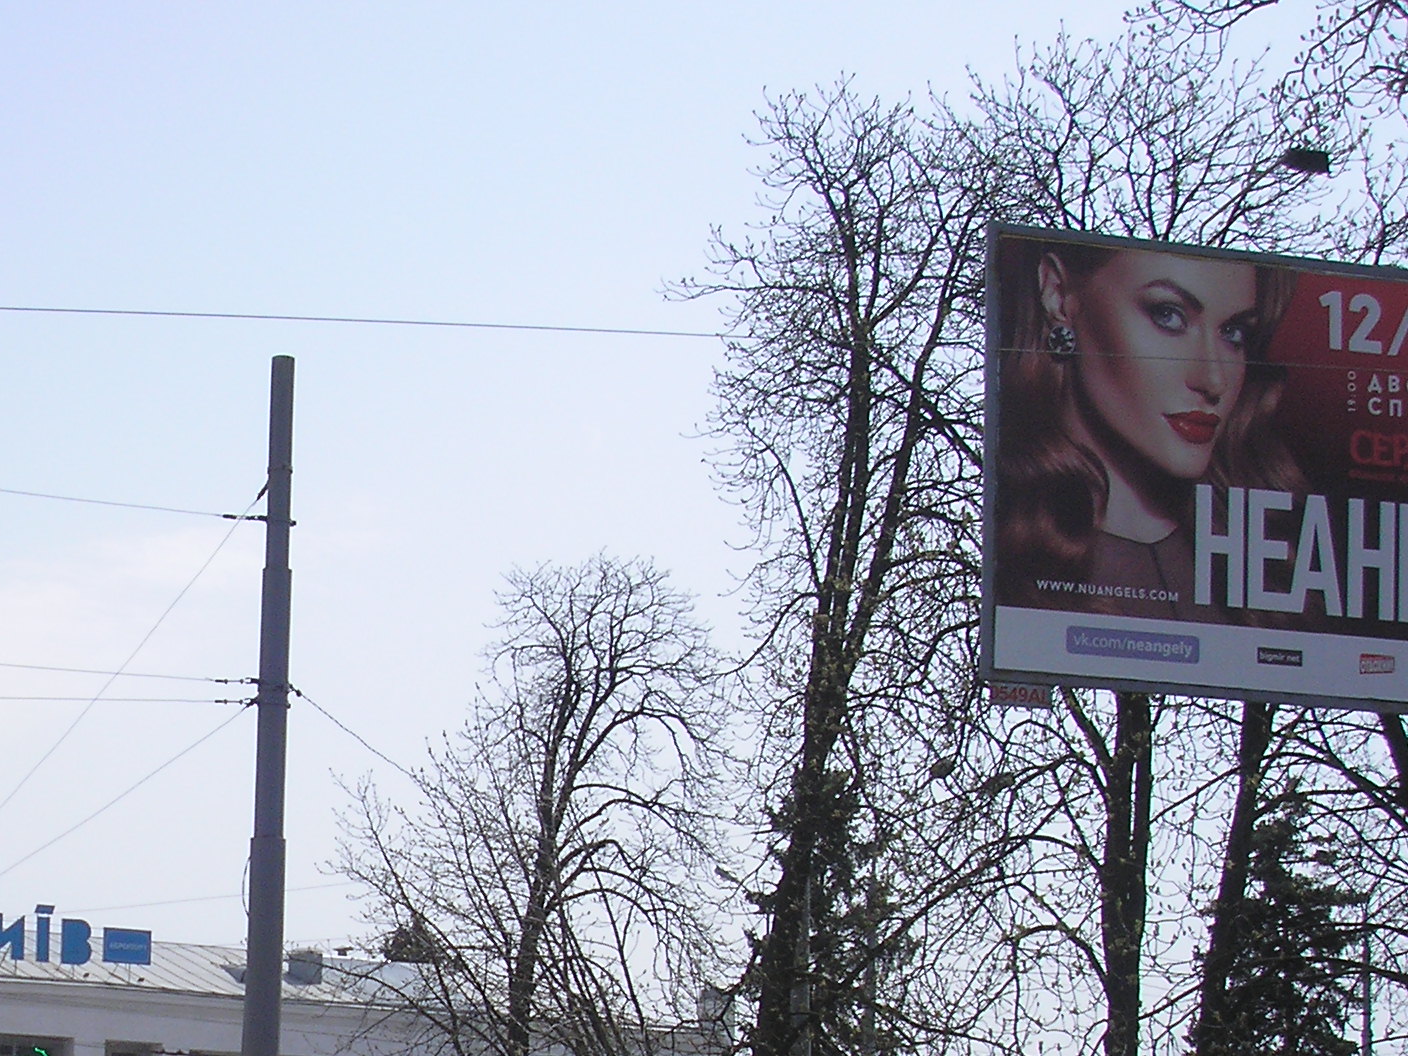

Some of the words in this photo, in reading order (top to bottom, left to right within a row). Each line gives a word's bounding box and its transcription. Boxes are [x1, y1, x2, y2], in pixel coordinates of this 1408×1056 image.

[1367, 372, 1408, 394] ДВ
[1036, 579, 1179, 602] WWW.NUANGELS.COM
[1073, 632, 1192, 658] vk.com/neangely
